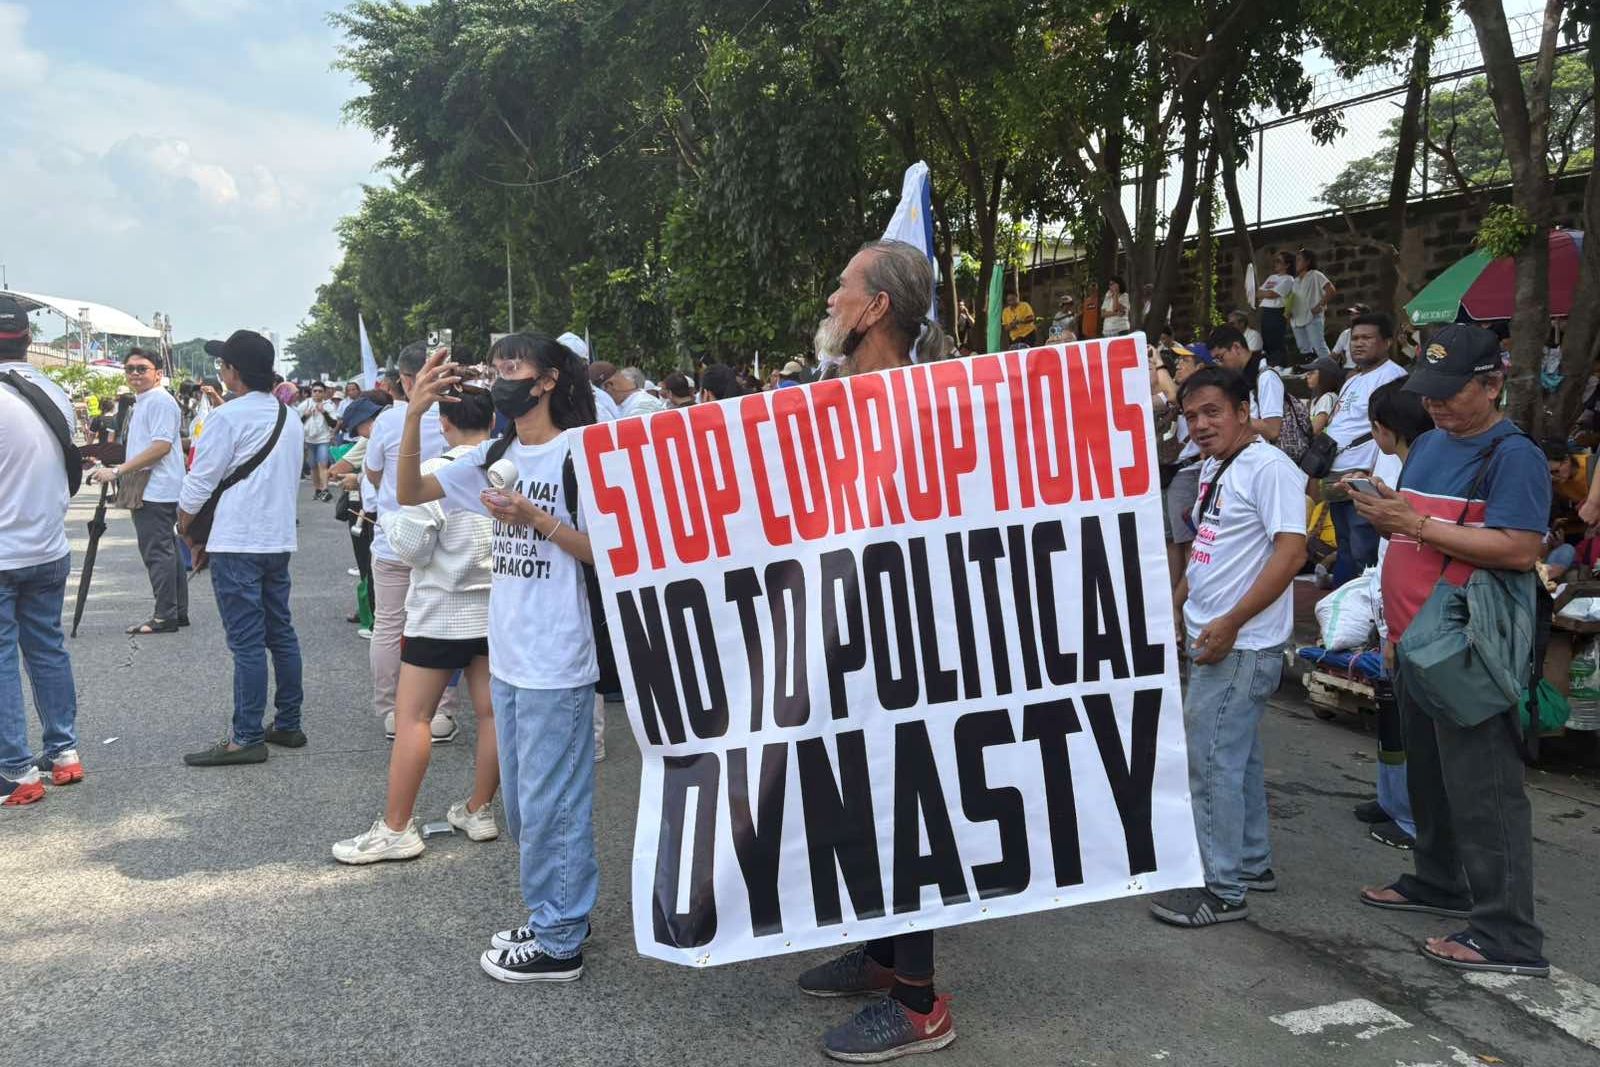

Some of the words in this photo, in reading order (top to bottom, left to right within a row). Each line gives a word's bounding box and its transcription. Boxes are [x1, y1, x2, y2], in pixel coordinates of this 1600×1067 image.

[516, 543, 538, 557] MGA
[527, 481, 559, 502] NA!
[583, 405, 741, 577] STOP
[741, 338, 1150, 547] CORRUPTIONS
[615, 578, 730, 746] NO
[724, 559, 811, 733] TO
[819, 512, 1165, 721] POLITICAL
[652, 687, 1163, 949] DYNASTY
